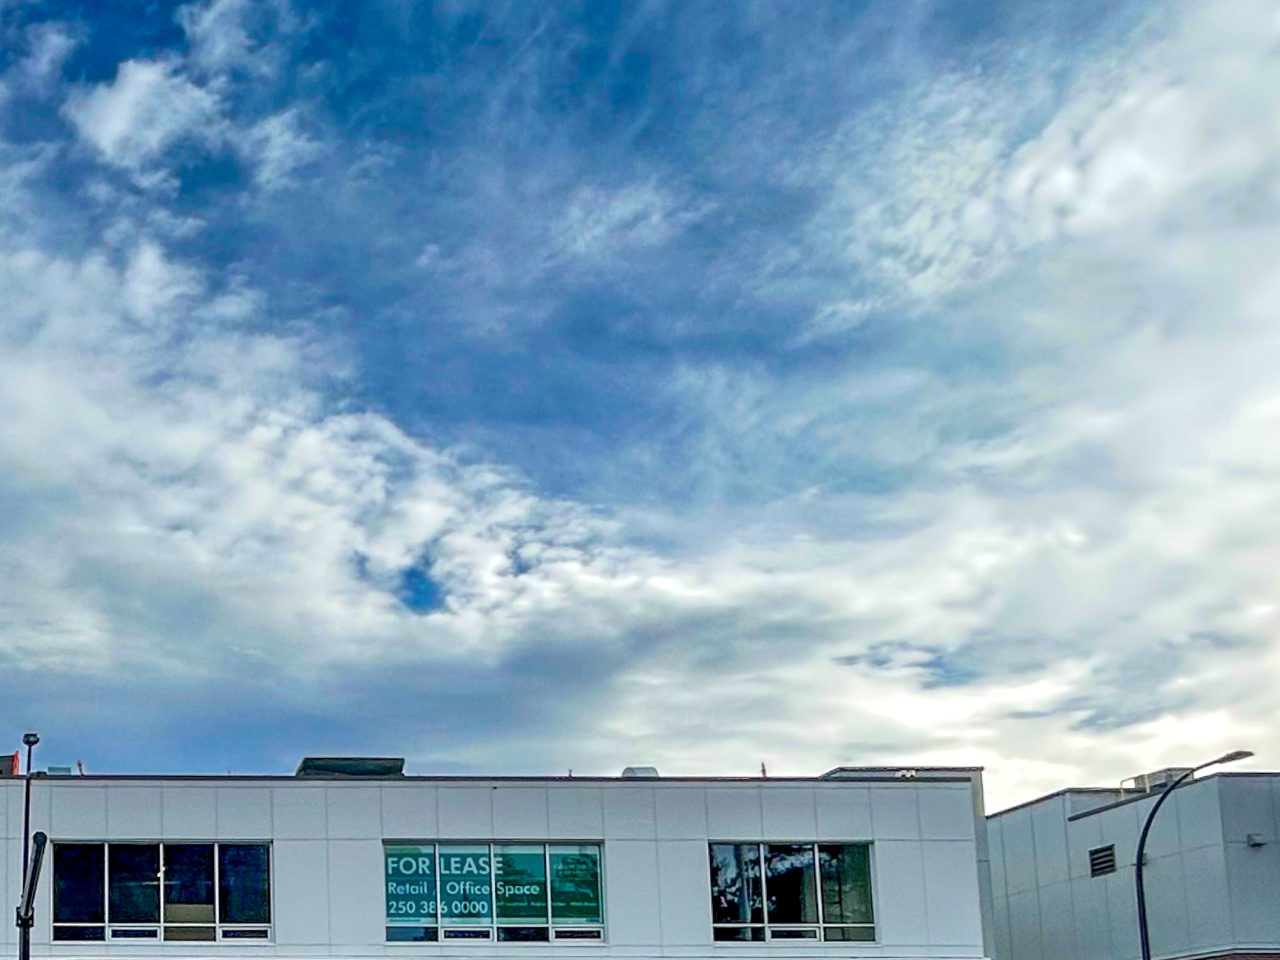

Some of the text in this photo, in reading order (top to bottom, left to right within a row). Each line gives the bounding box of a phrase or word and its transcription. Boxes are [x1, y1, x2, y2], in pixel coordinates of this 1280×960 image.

[387, 857, 504, 875] FOR LEASE
[387, 881, 428, 895] Retail
[446, 881, 490, 895] Office
[496, 882, 540, 898] Space
[388, 901, 489, 914] 250 386 0000
